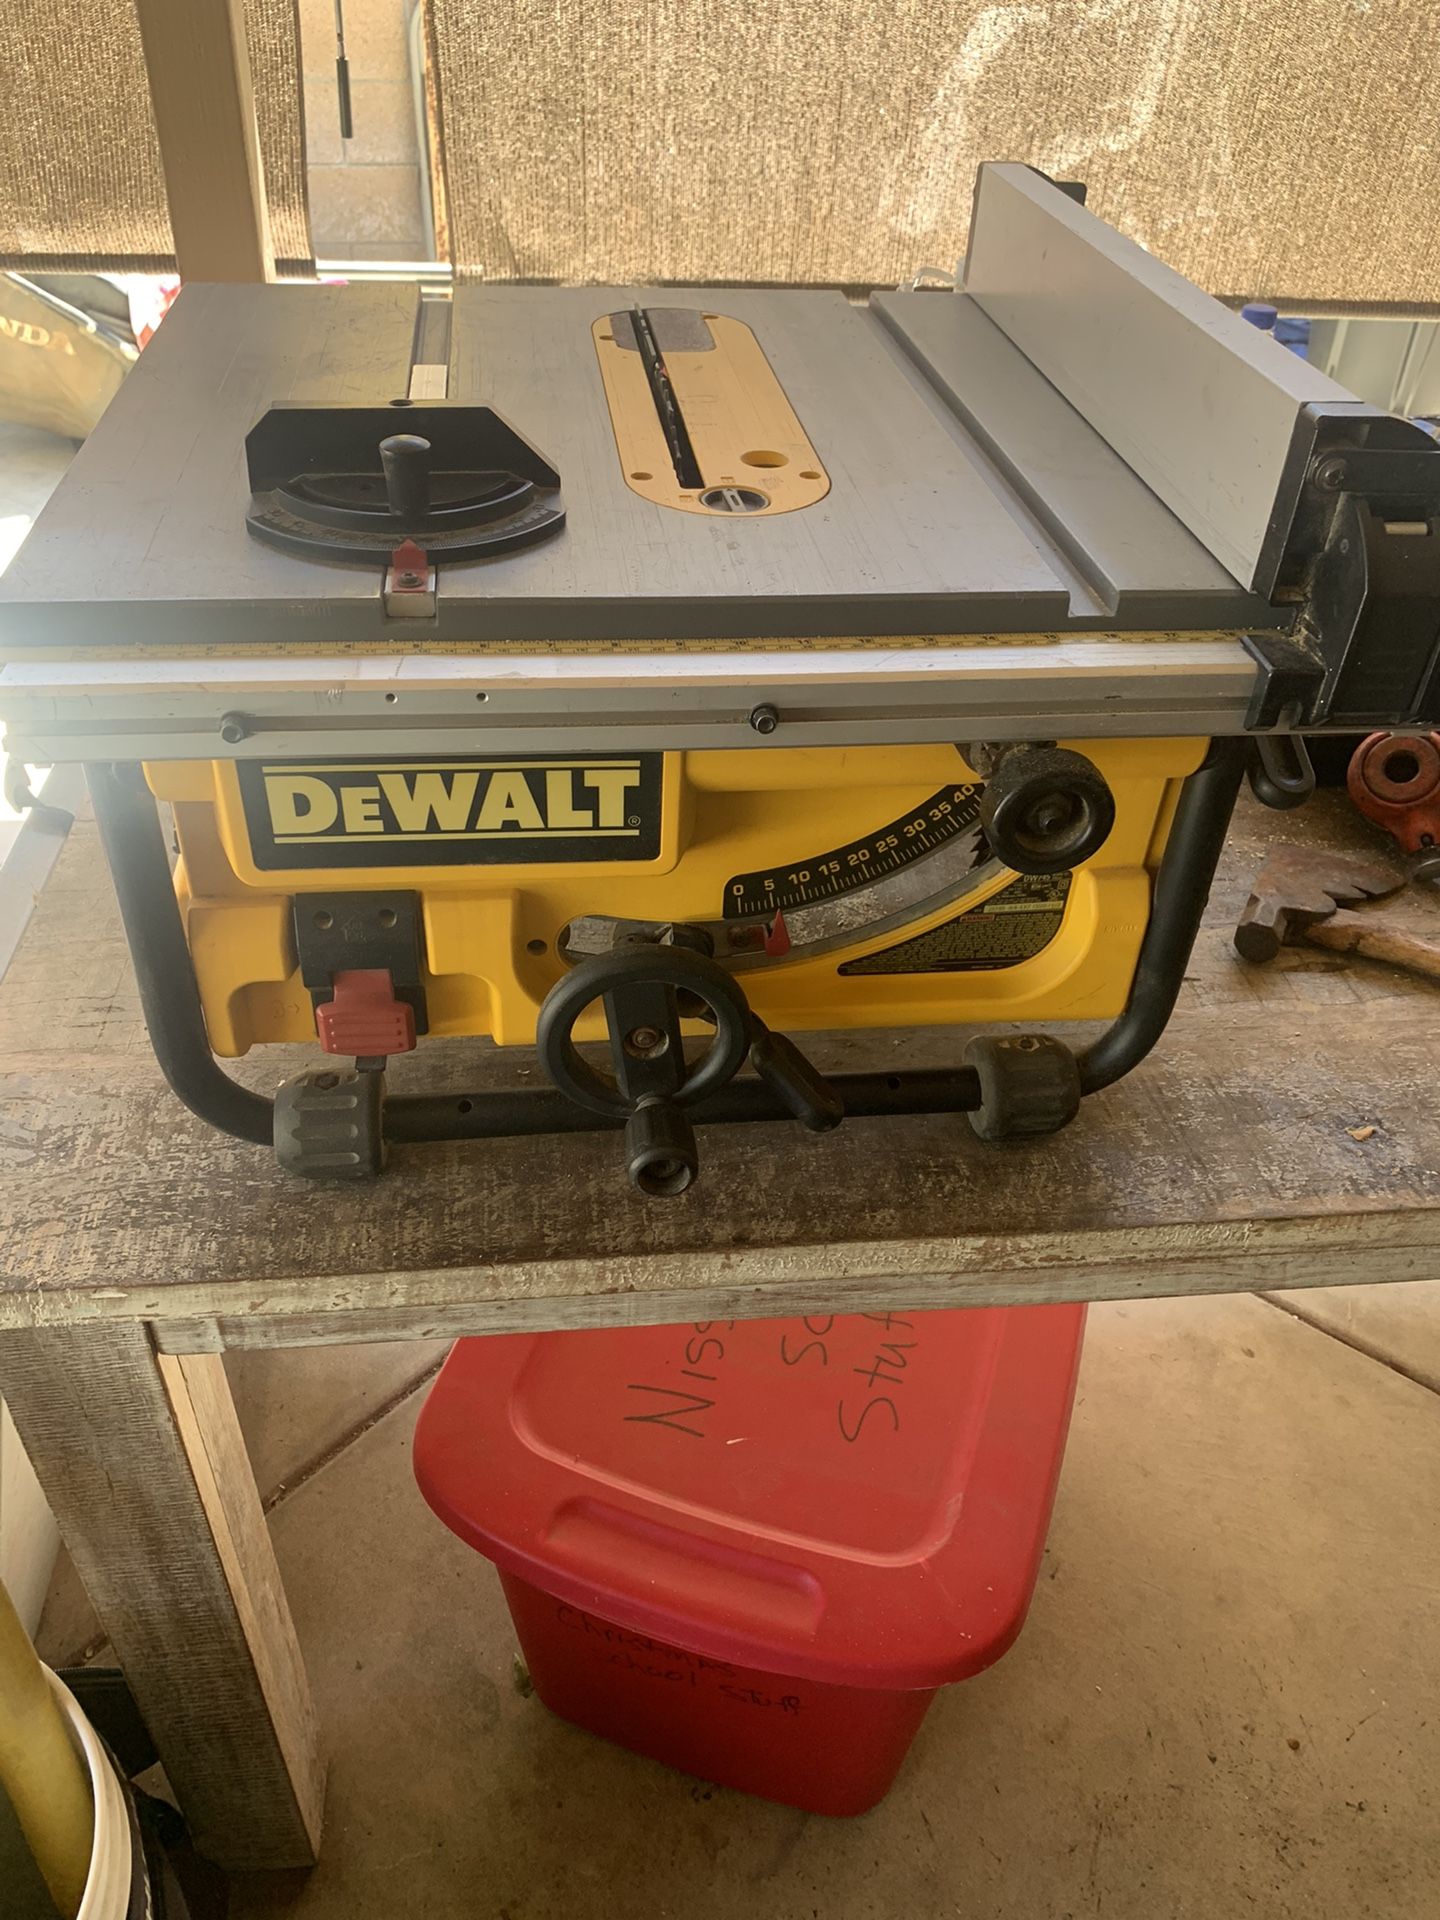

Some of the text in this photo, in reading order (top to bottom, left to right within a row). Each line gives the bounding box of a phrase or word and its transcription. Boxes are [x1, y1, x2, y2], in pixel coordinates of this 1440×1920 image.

[732, 783, 975, 896] 0 5 10 15 20 25 30 35 40
